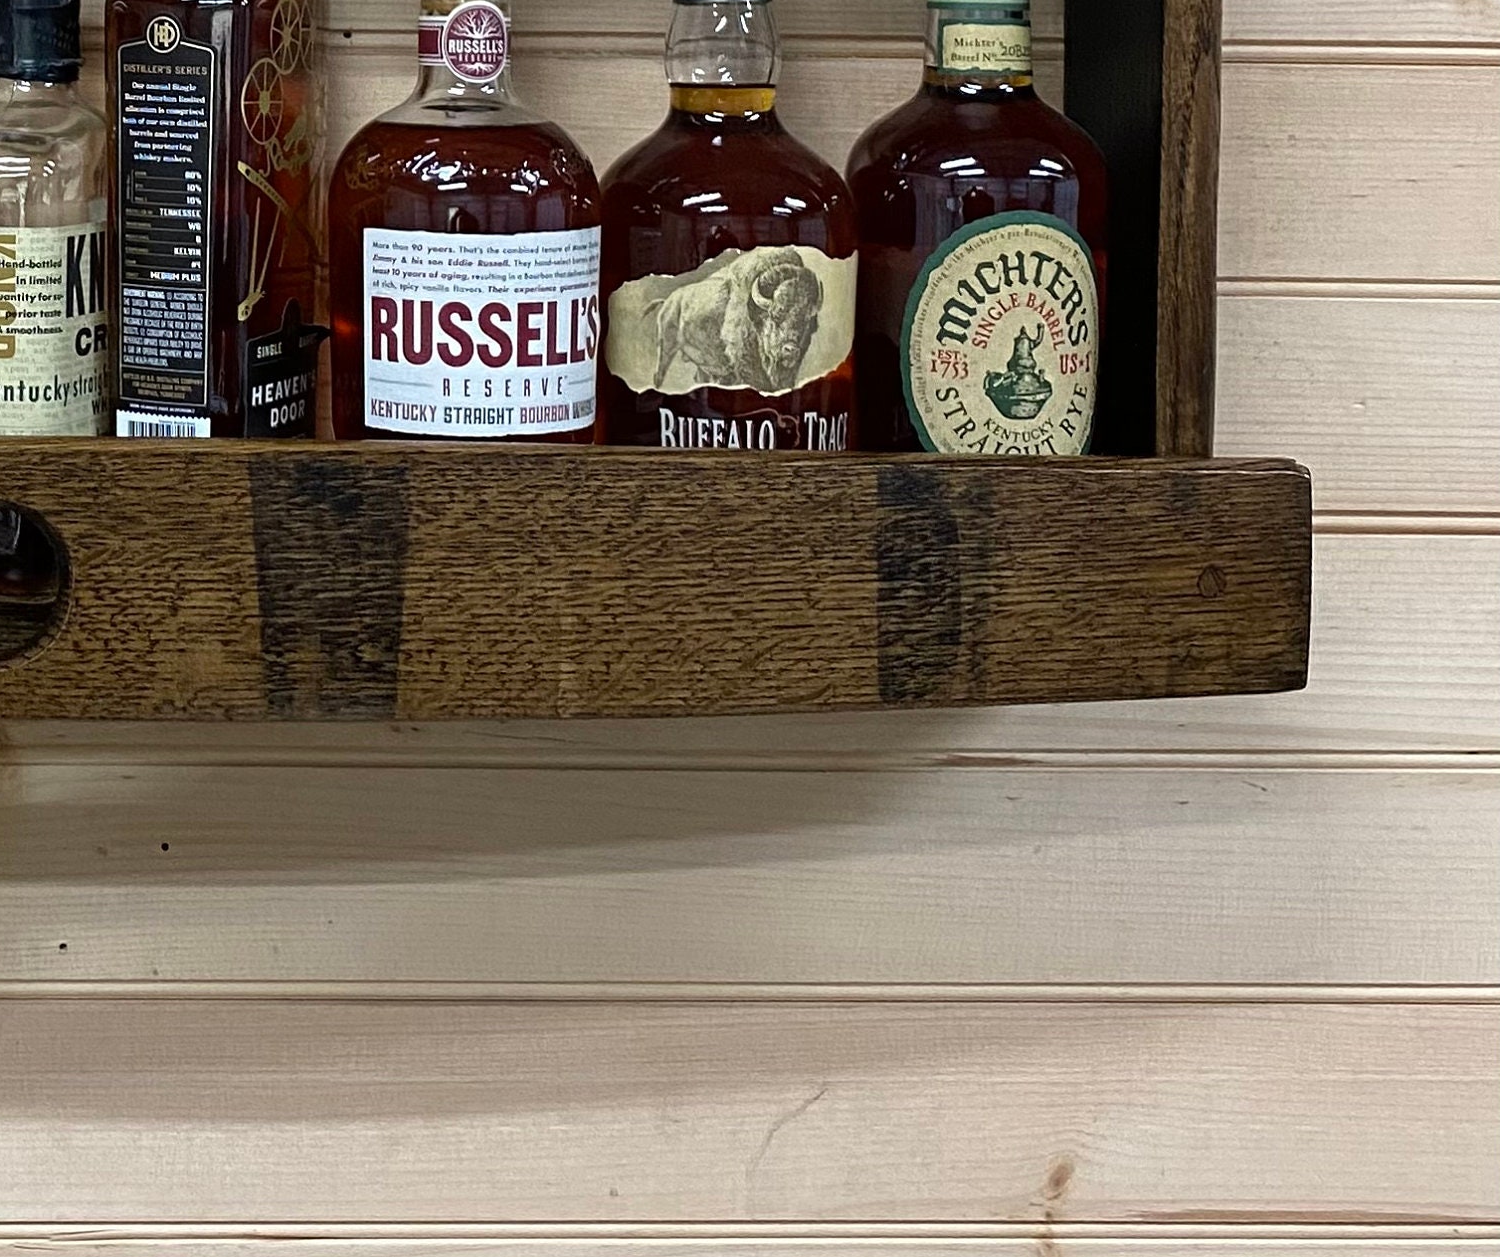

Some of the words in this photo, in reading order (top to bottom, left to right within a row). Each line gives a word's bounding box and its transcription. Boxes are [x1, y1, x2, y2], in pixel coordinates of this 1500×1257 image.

[448, 39, 504, 54] RUSSELL'S
[954, 37, 1005, 47] Michter's
[950, 52, 980, 62] Barrel
[123, 63, 172, 74] DISTILLER'S
[174, 65, 208, 76] SERIES
[186, 183, 202, 193] 10%
[186, 196, 202, 205] 10%
[411, 243, 423, 251] 90
[427, 246, 456, 255] years.
[459, 245, 484, 255] That's
[486, 246, 500, 254] the
[502, 246, 539, 254] combined
[400, 256, 408, 264] &
[411, 256, 423, 264] his
[427, 258, 444, 266] son
[447, 258, 474, 267] Eddie
[513, 259, 532, 269] They
[29, 274, 62, 285] limited
[181, 273, 202, 282] PLUS
[391, 267, 401, 276] 10
[402, 270, 427, 279] years
[440, 271, 471, 282] aging,
[508, 272, 516, 280] in
[524, 271, 554, 280] Bourbon
[399, 282, 419, 292] spicy
[453, 284, 485, 293] flavors.
[488, 285, 510, 293] Their
[513, 285, 557, 295] experience
[936, 250, 1089, 348] MICHTER'S
[40, 309, 62, 318] taste
[971, 292, 1020, 349] SINGLE
[1026, 292, 1066, 351] BARREL
[370, 294, 599, 368] RUSSELL'S
[256, 342, 282, 359] SINGLE
[937, 350, 964, 360] EST.
[930, 359, 969, 379] 1753
[442, 375, 564, 397] RESERVE
[270, 400, 306, 428] DOOR
[370, 398, 437, 423] KENTUCKY
[443, 406, 514, 425] STRAIGHT
[520, 403, 570, 425] BOURBON
[983, 417, 1055, 444] KENTUCKY
